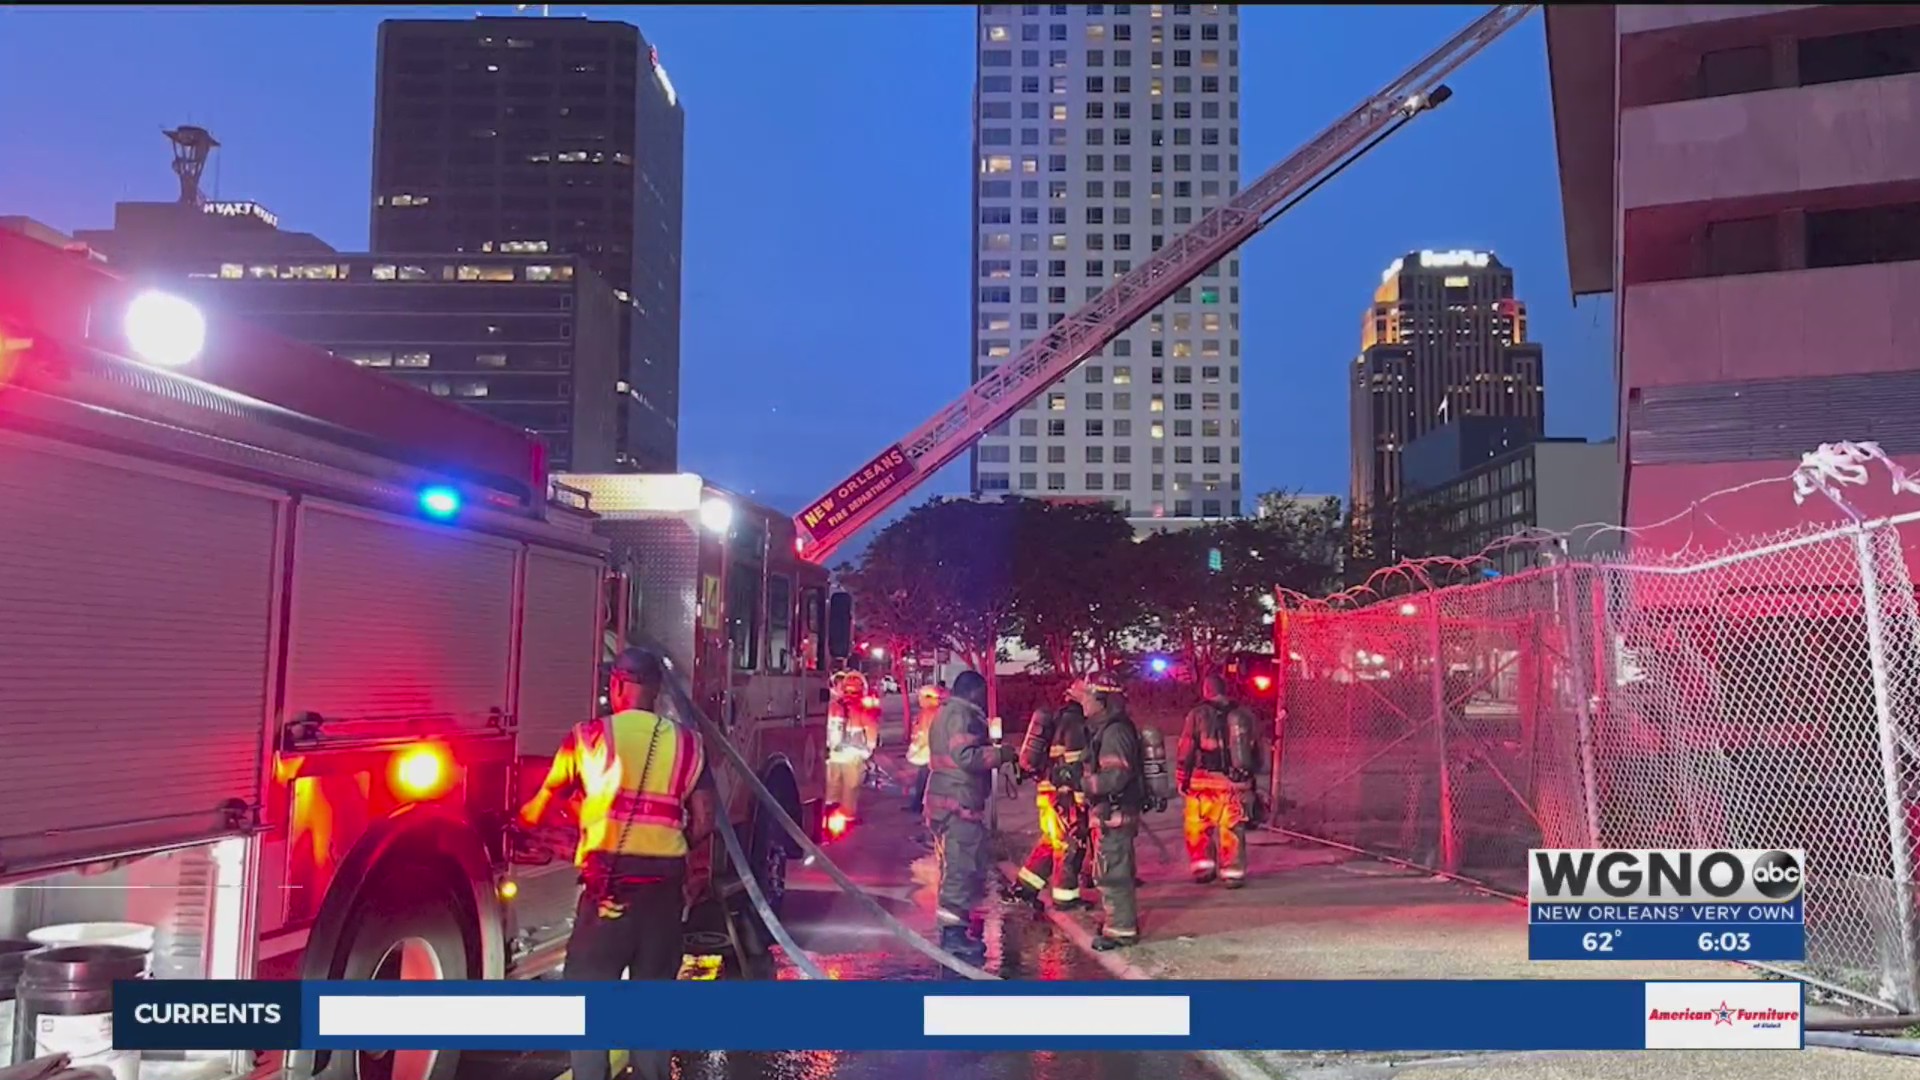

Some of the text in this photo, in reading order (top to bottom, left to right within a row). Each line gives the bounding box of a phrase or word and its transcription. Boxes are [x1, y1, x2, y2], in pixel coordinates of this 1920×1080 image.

[203, 203, 253, 216] HYATT
[804, 450, 904, 528] NEW ORLEANS
[827, 473, 896, 527] FIRE DEPARTMENT
